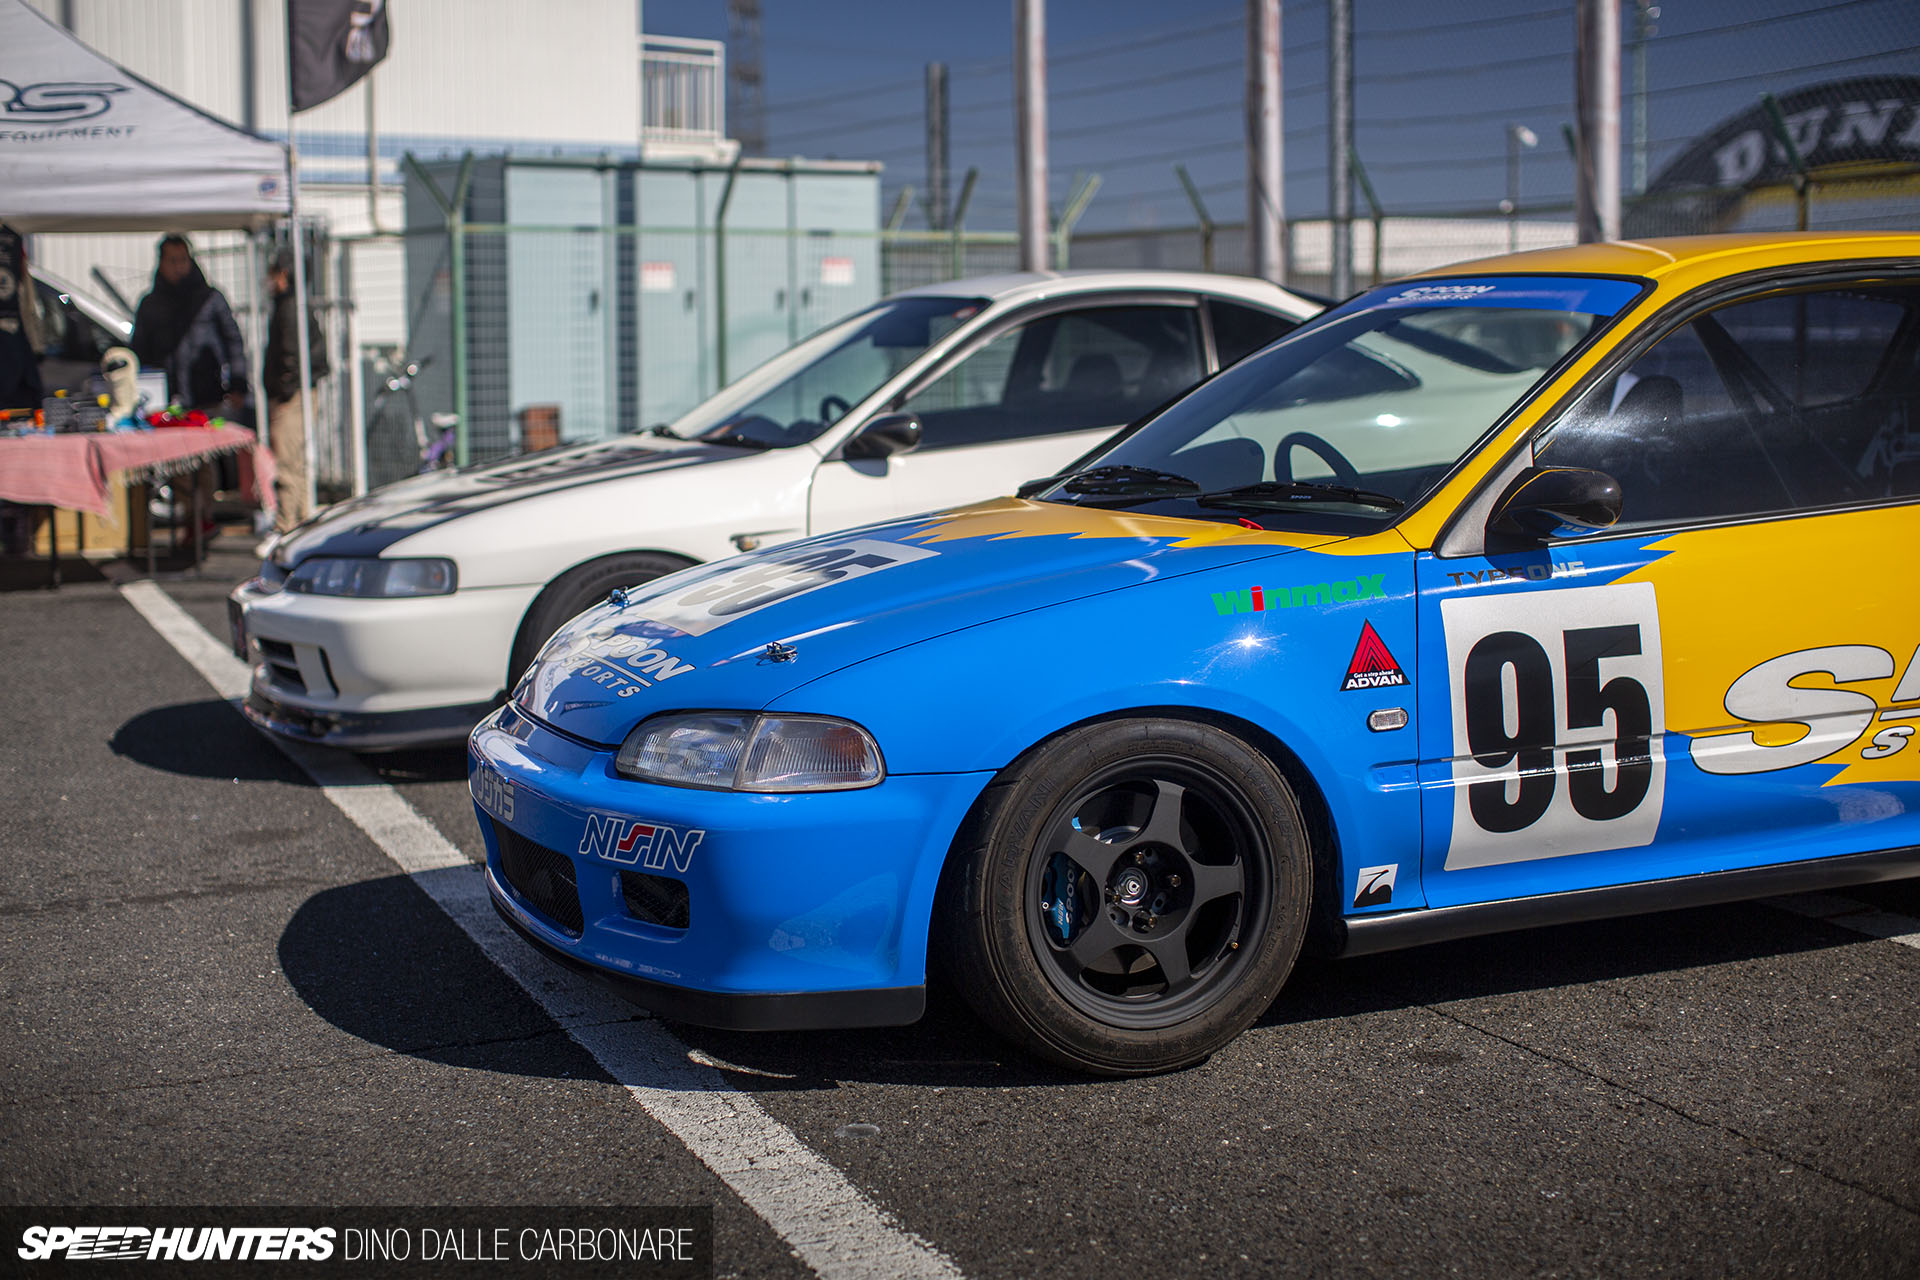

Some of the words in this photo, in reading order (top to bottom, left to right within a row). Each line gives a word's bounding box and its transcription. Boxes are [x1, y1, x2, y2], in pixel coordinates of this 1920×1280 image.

[542, 626, 698, 682] SPOON
[560, 656, 642, 699] SPORTS
[1345, 674, 1403, 689] ADVAN
[1465, 623, 1653, 834] 95
[1065, 862, 1076, 925] SPOO
